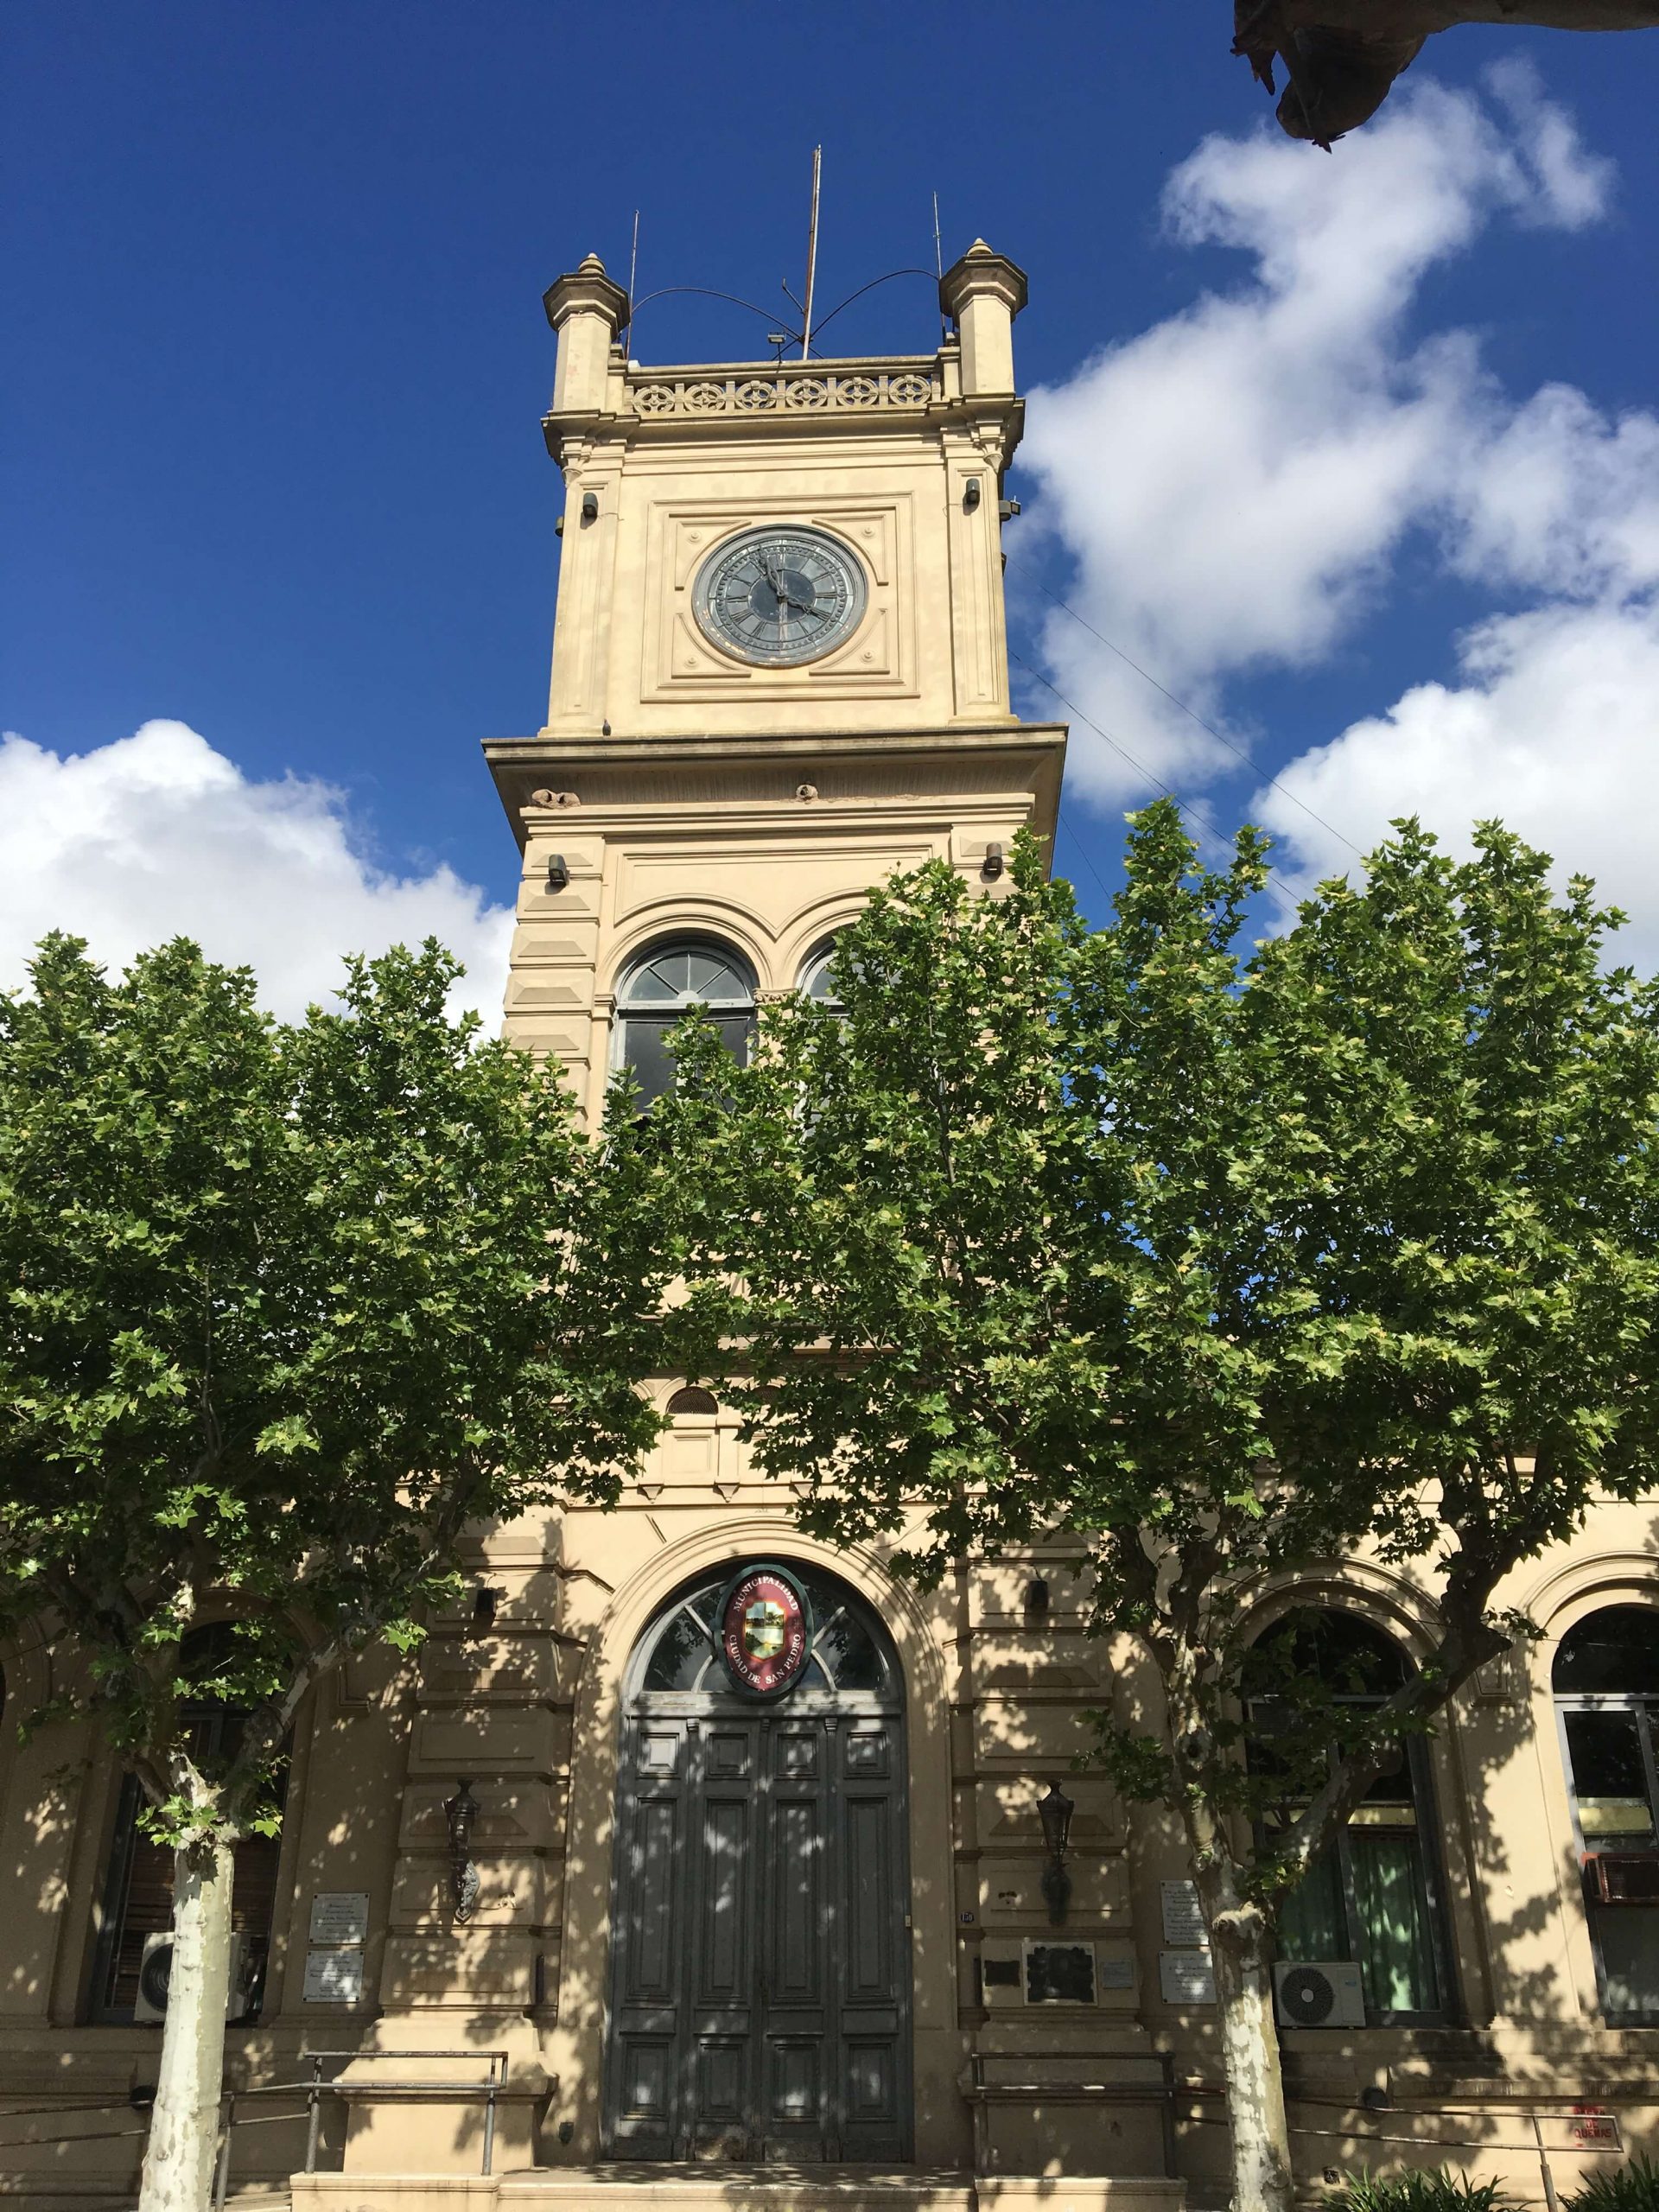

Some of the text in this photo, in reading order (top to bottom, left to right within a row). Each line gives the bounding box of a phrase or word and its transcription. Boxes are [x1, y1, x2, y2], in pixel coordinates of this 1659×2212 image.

[734, 1576, 799, 1612] MUNICIPALIDAD
[729, 1634, 802, 1684] CIUDAD DE SAN PEDRO
[1574, 2128, 1611, 2139] QUEMAS
